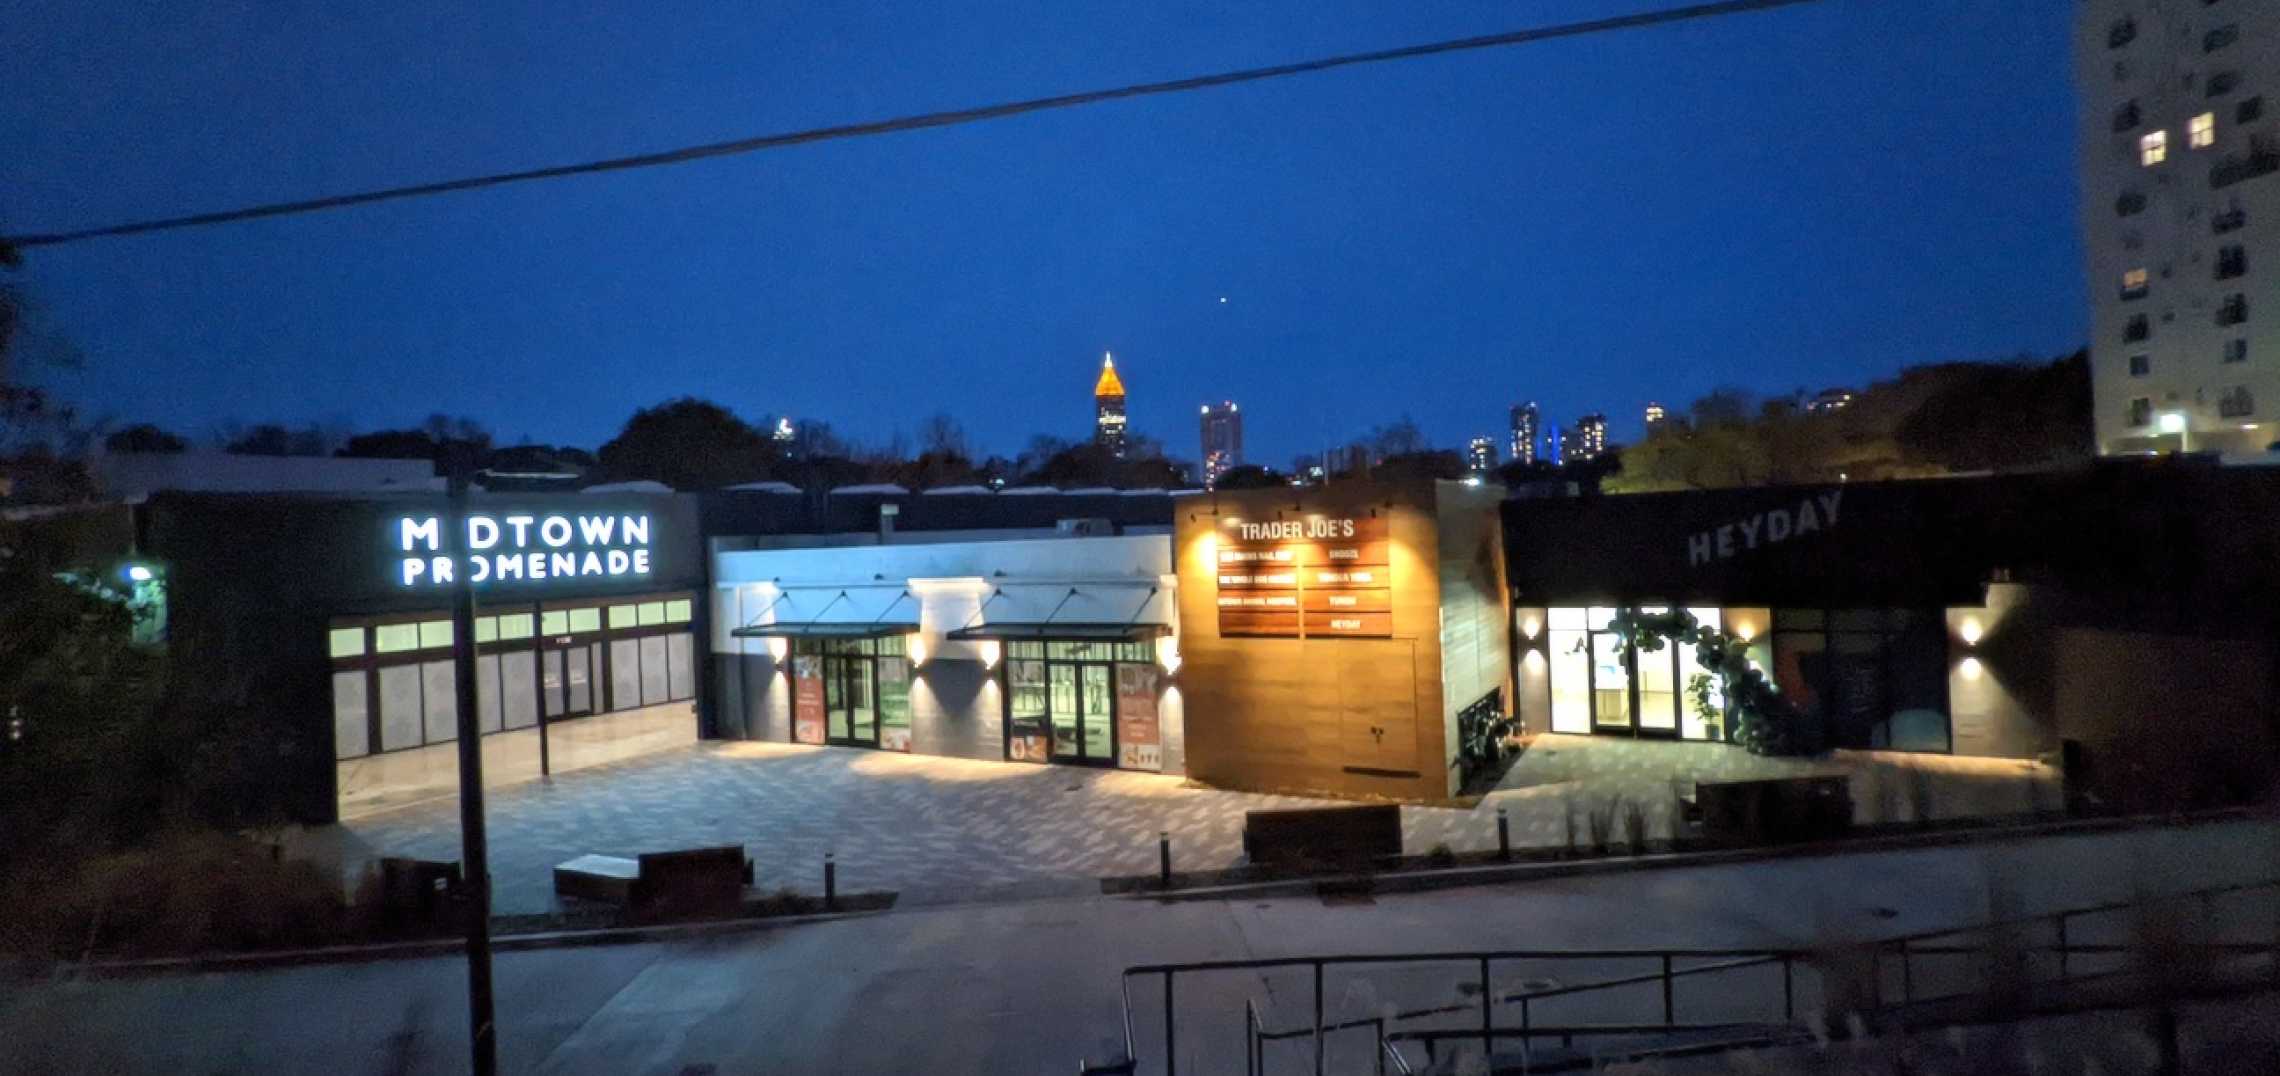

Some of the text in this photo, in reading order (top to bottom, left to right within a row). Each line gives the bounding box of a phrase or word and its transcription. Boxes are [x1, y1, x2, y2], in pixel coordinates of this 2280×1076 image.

[401, 515, 648, 551] MDTOWN
[1240, 519, 1354, 540] TRADER JOE'S
[1688, 491, 1841, 566] HEYDAY
[403, 549, 649, 586] PROMENADE
